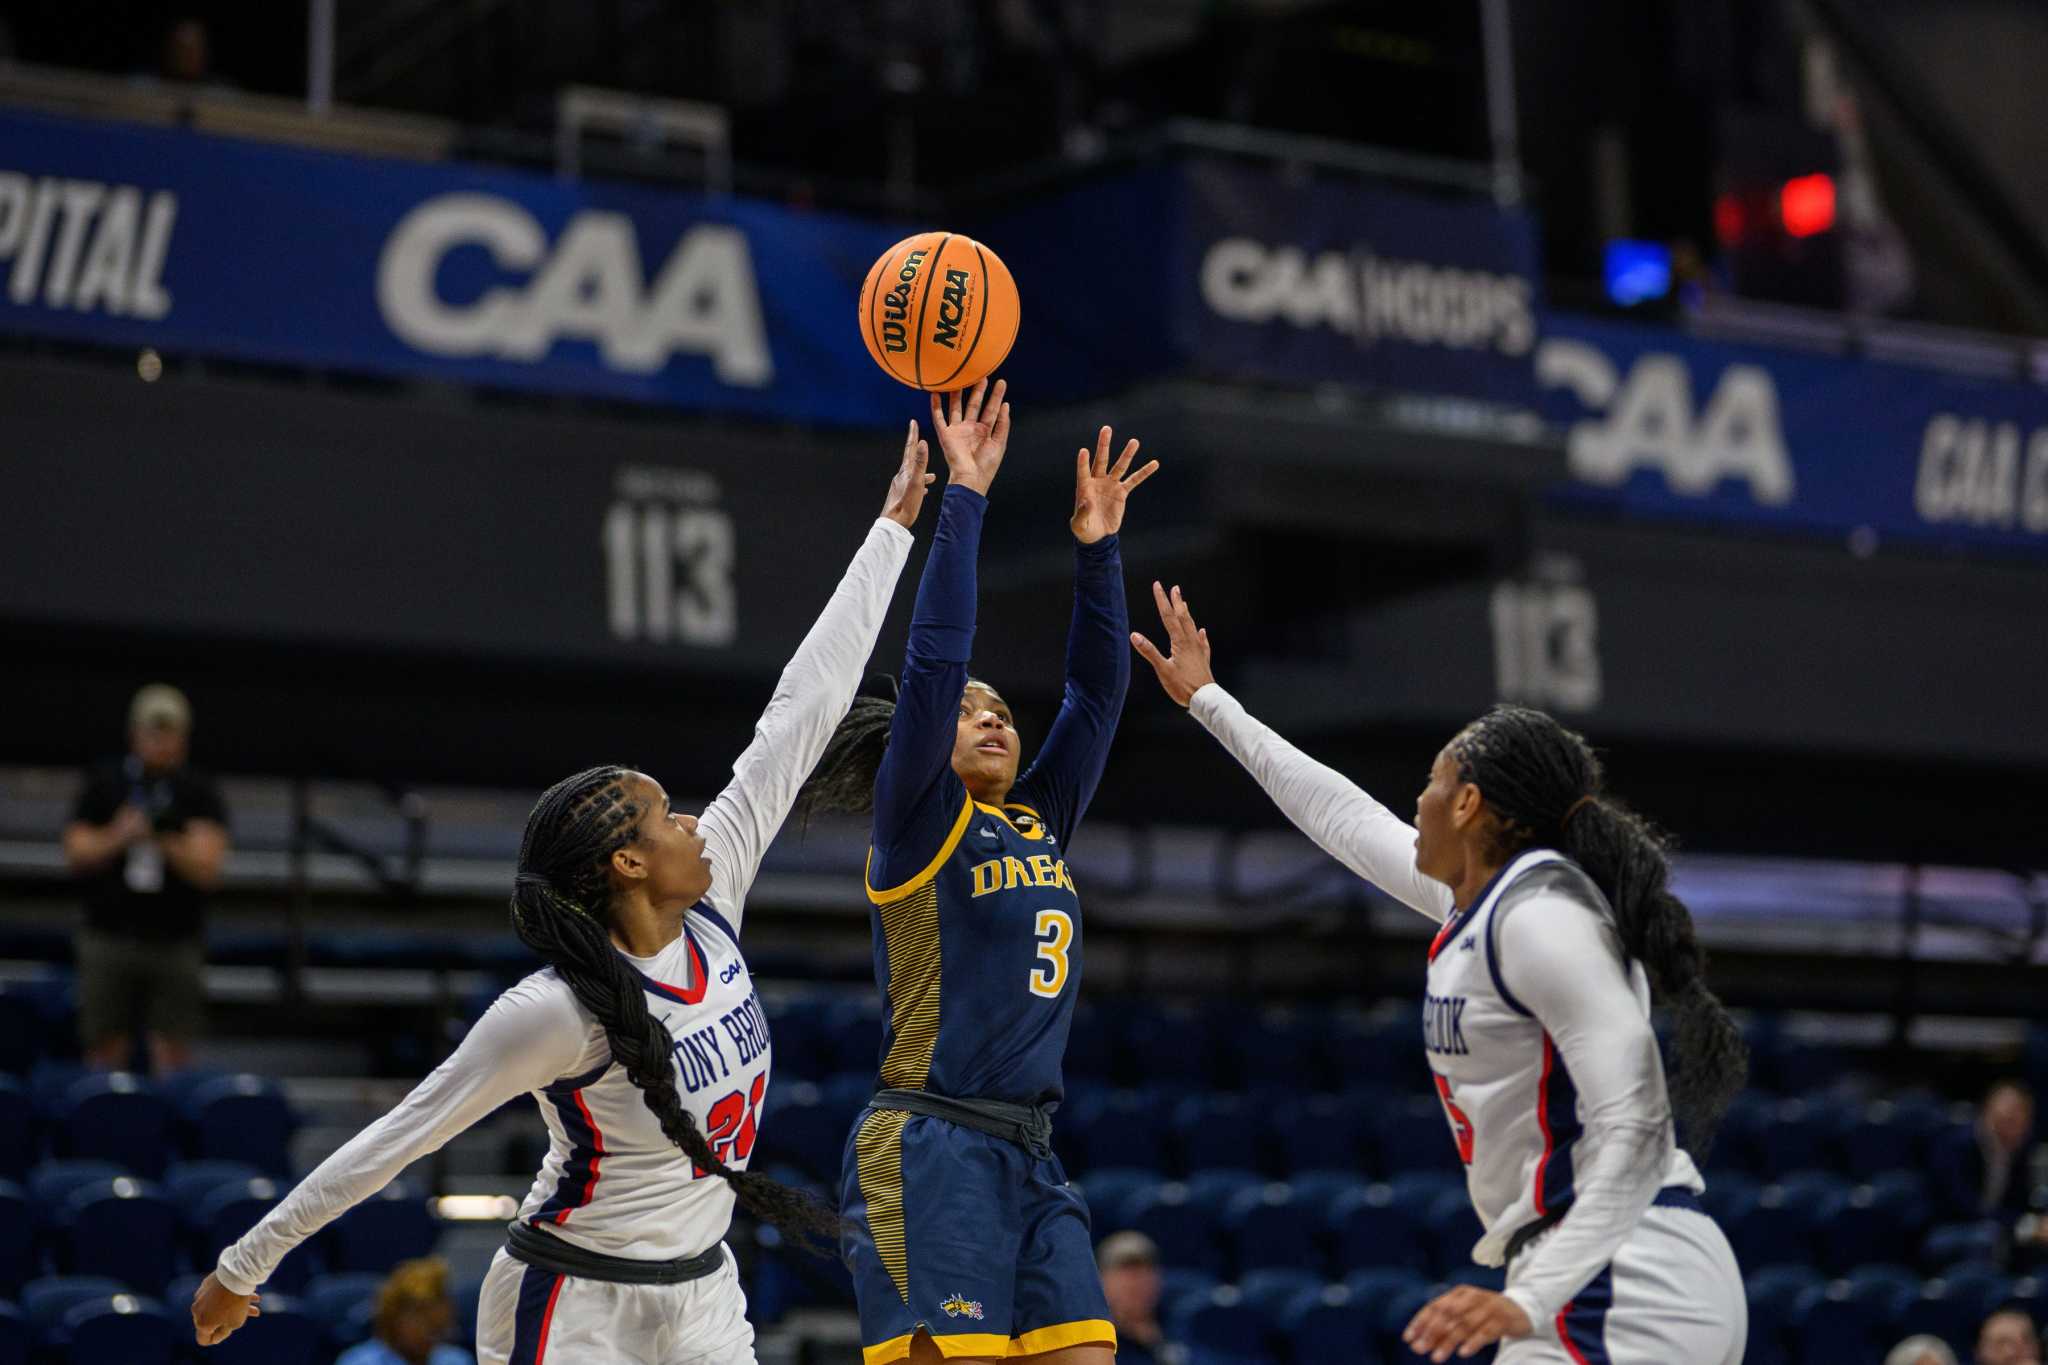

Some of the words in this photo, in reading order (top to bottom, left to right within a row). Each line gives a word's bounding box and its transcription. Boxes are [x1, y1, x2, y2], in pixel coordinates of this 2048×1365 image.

[377, 194, 775, 388] CAA
[882, 249, 929, 353] Wilson
[933, 269, 969, 350] NCAA
[1202, 238, 1353, 335] CAA
[604, 504, 738, 645] 113
[1029, 909, 1074, 998] 3
[674, 1025, 730, 1094] ONY
